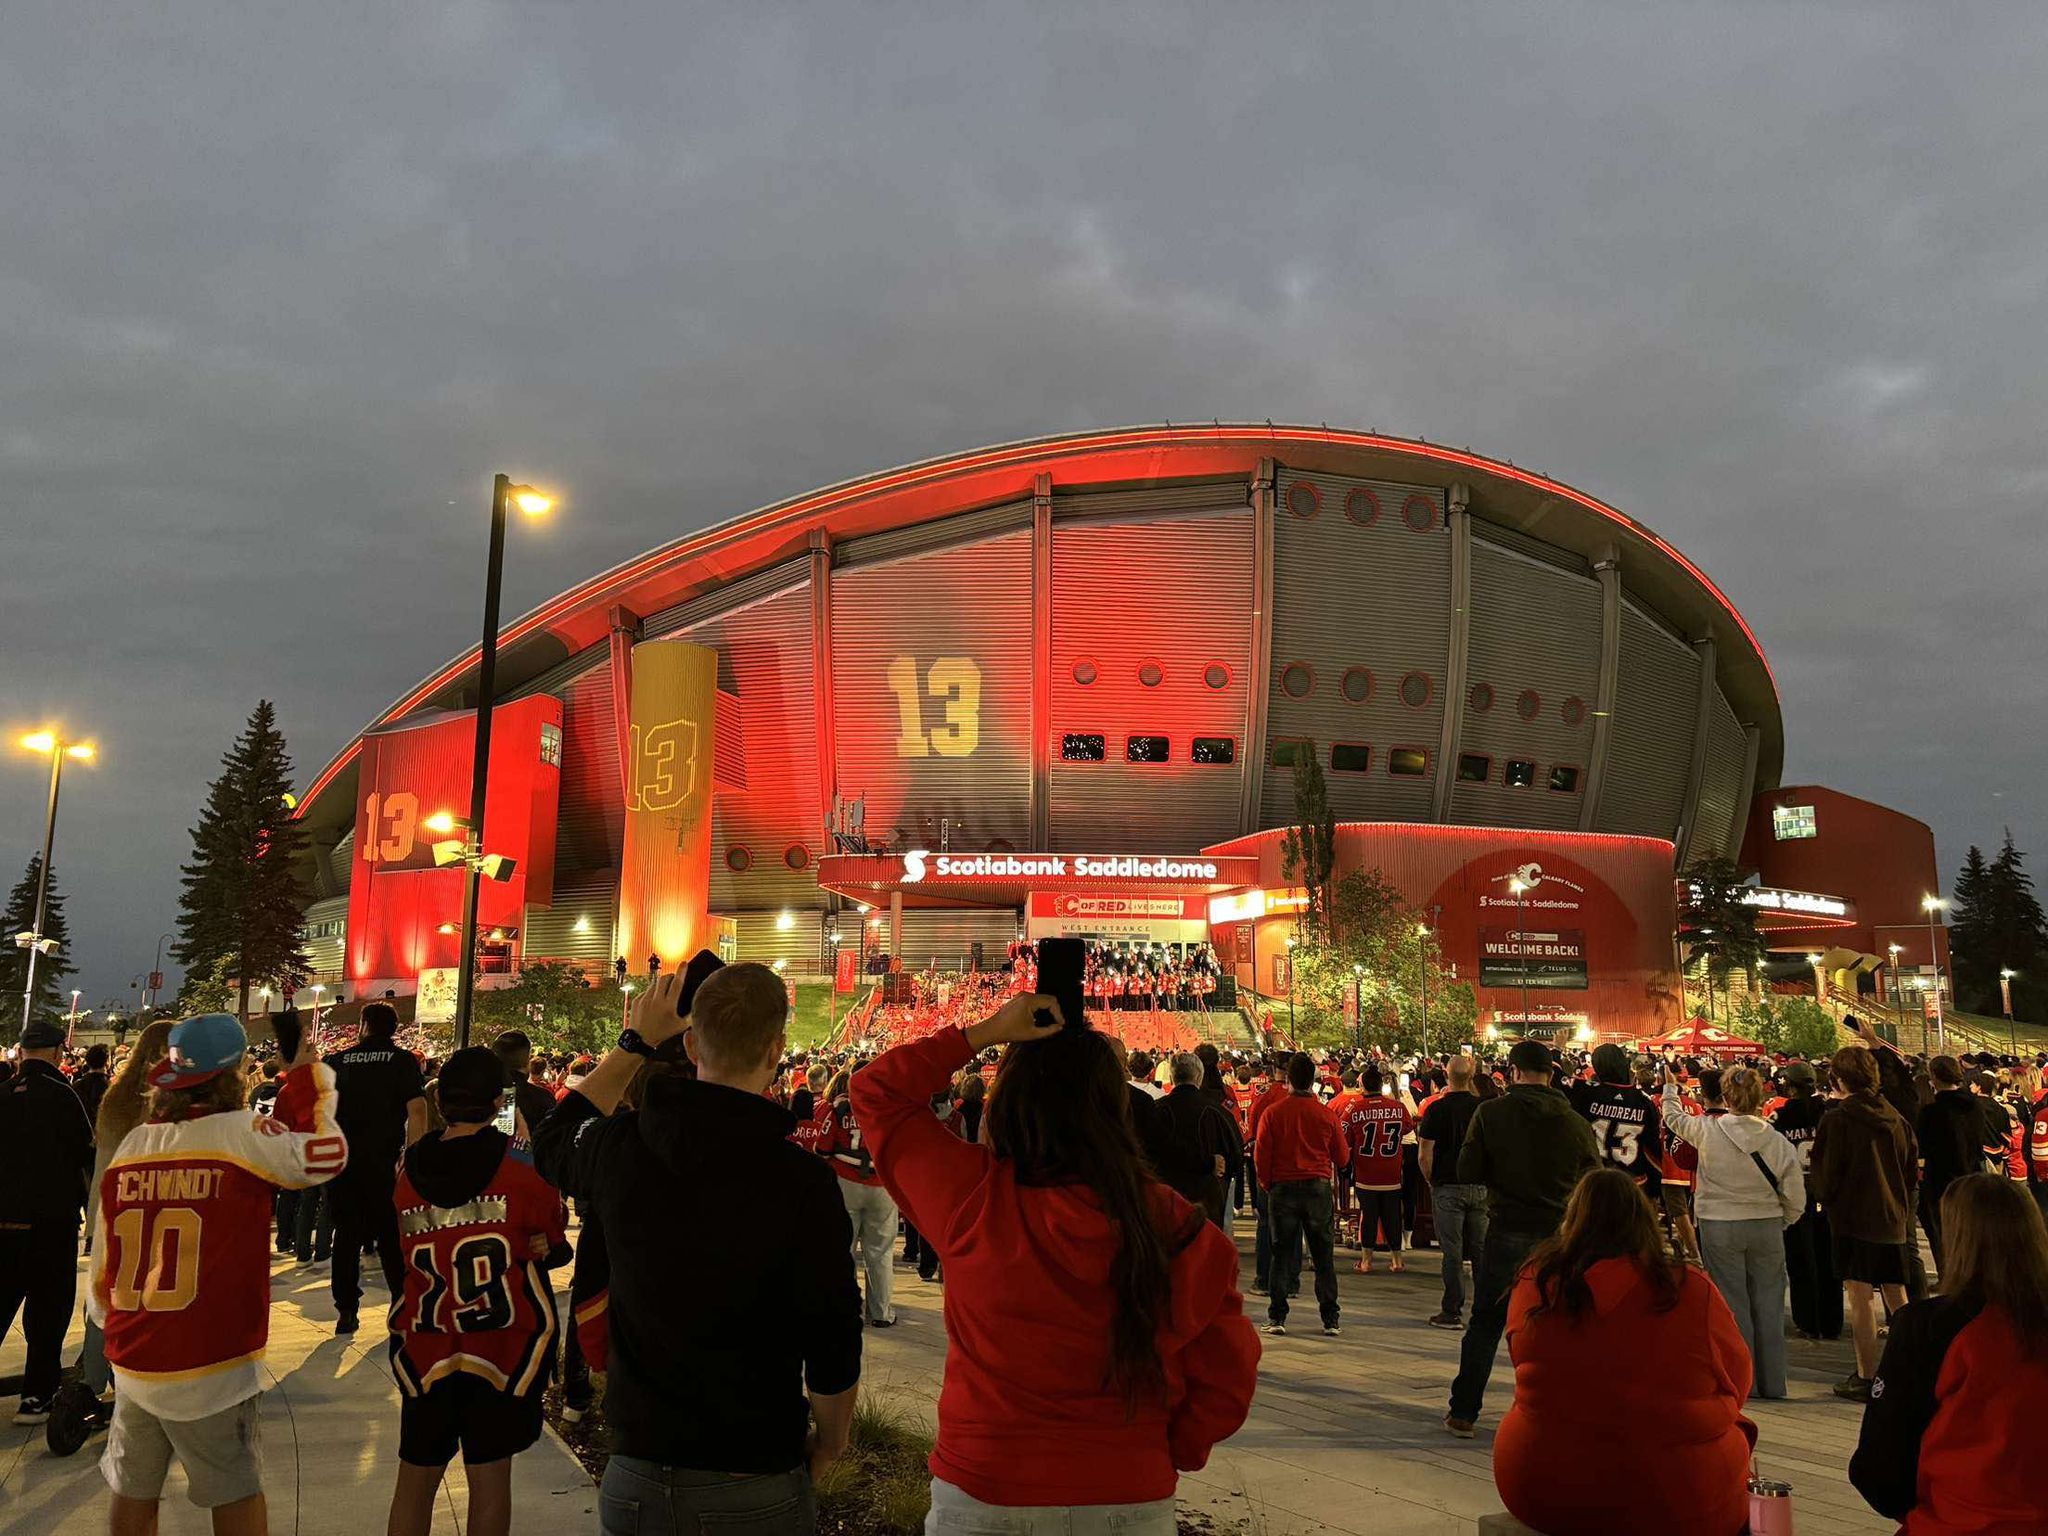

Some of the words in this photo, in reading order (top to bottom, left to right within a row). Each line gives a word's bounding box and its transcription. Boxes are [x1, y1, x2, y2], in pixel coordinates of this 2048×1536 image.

[887, 656, 981, 757] 13
[627, 719, 698, 811] 13
[363, 792, 419, 861] 13
[936, 856, 1067, 876] Scotiabank
[1074, 857, 1217, 878] Saddledome
[1081, 901, 1096, 910] OF
[1098, 901, 1127, 912] RED
[1533, 899, 1579, 910] Saddledome
[1062, 924, 1089, 932] WEST
[1095, 924, 1151, 933] ENTRANCE
[1486, 943, 1543, 956] WELCOME
[1545, 945, 1579, 956] BACK!
[342, 1051, 394, 1064] SECURITY
[1351, 1108, 1403, 1123] GAUDREAU
[1590, 1102, 1645, 1122] GAUDREAU
[1360, 1120, 1403, 1157] 13
[1592, 1119, 1645, 1166] 13
[112, 1208, 202, 1312] 10
[411, 1232, 515, 1333] 19
